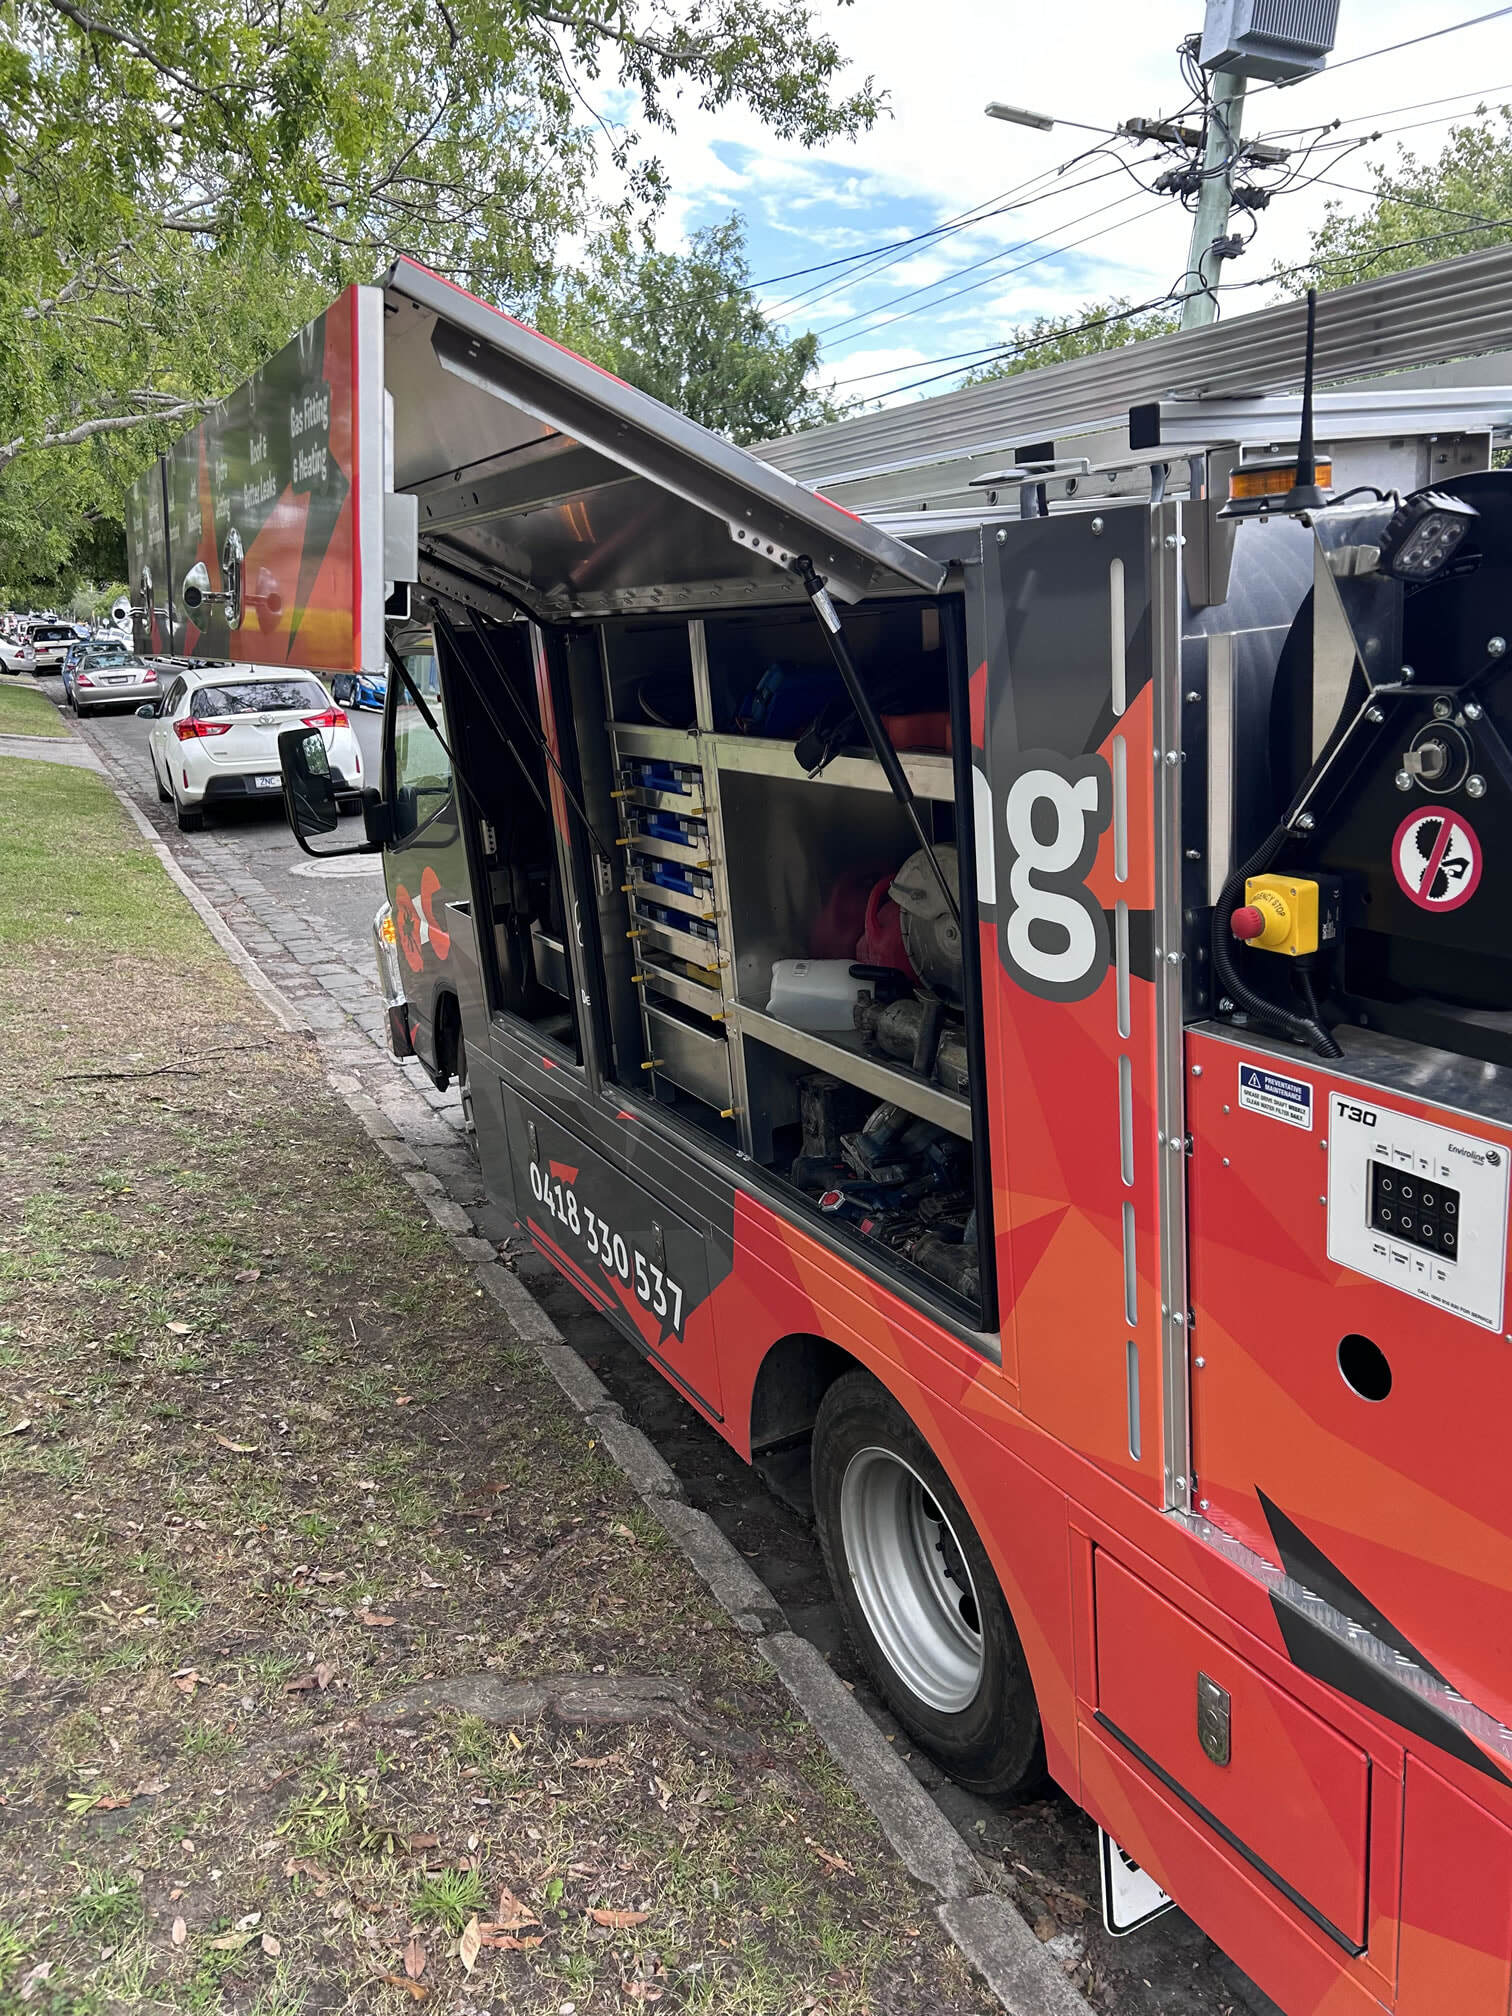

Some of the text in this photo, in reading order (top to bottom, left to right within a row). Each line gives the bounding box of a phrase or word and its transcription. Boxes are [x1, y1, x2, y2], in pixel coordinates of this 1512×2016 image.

[291, 391, 328, 438] Gas Fitting
[299, 441, 327, 480] Heating
[1272, 899, 1286, 917] STOP
[1265, 1077, 1302, 1095] PREVENTATIVE
[1265, 1084, 1302, 1102] MAINTENANCE
[1337, 1102, 1377, 1127] T30
[1448, 1144, 1485, 1163] Enviroline
[529, 1161, 684, 1332] 0418 330 537
